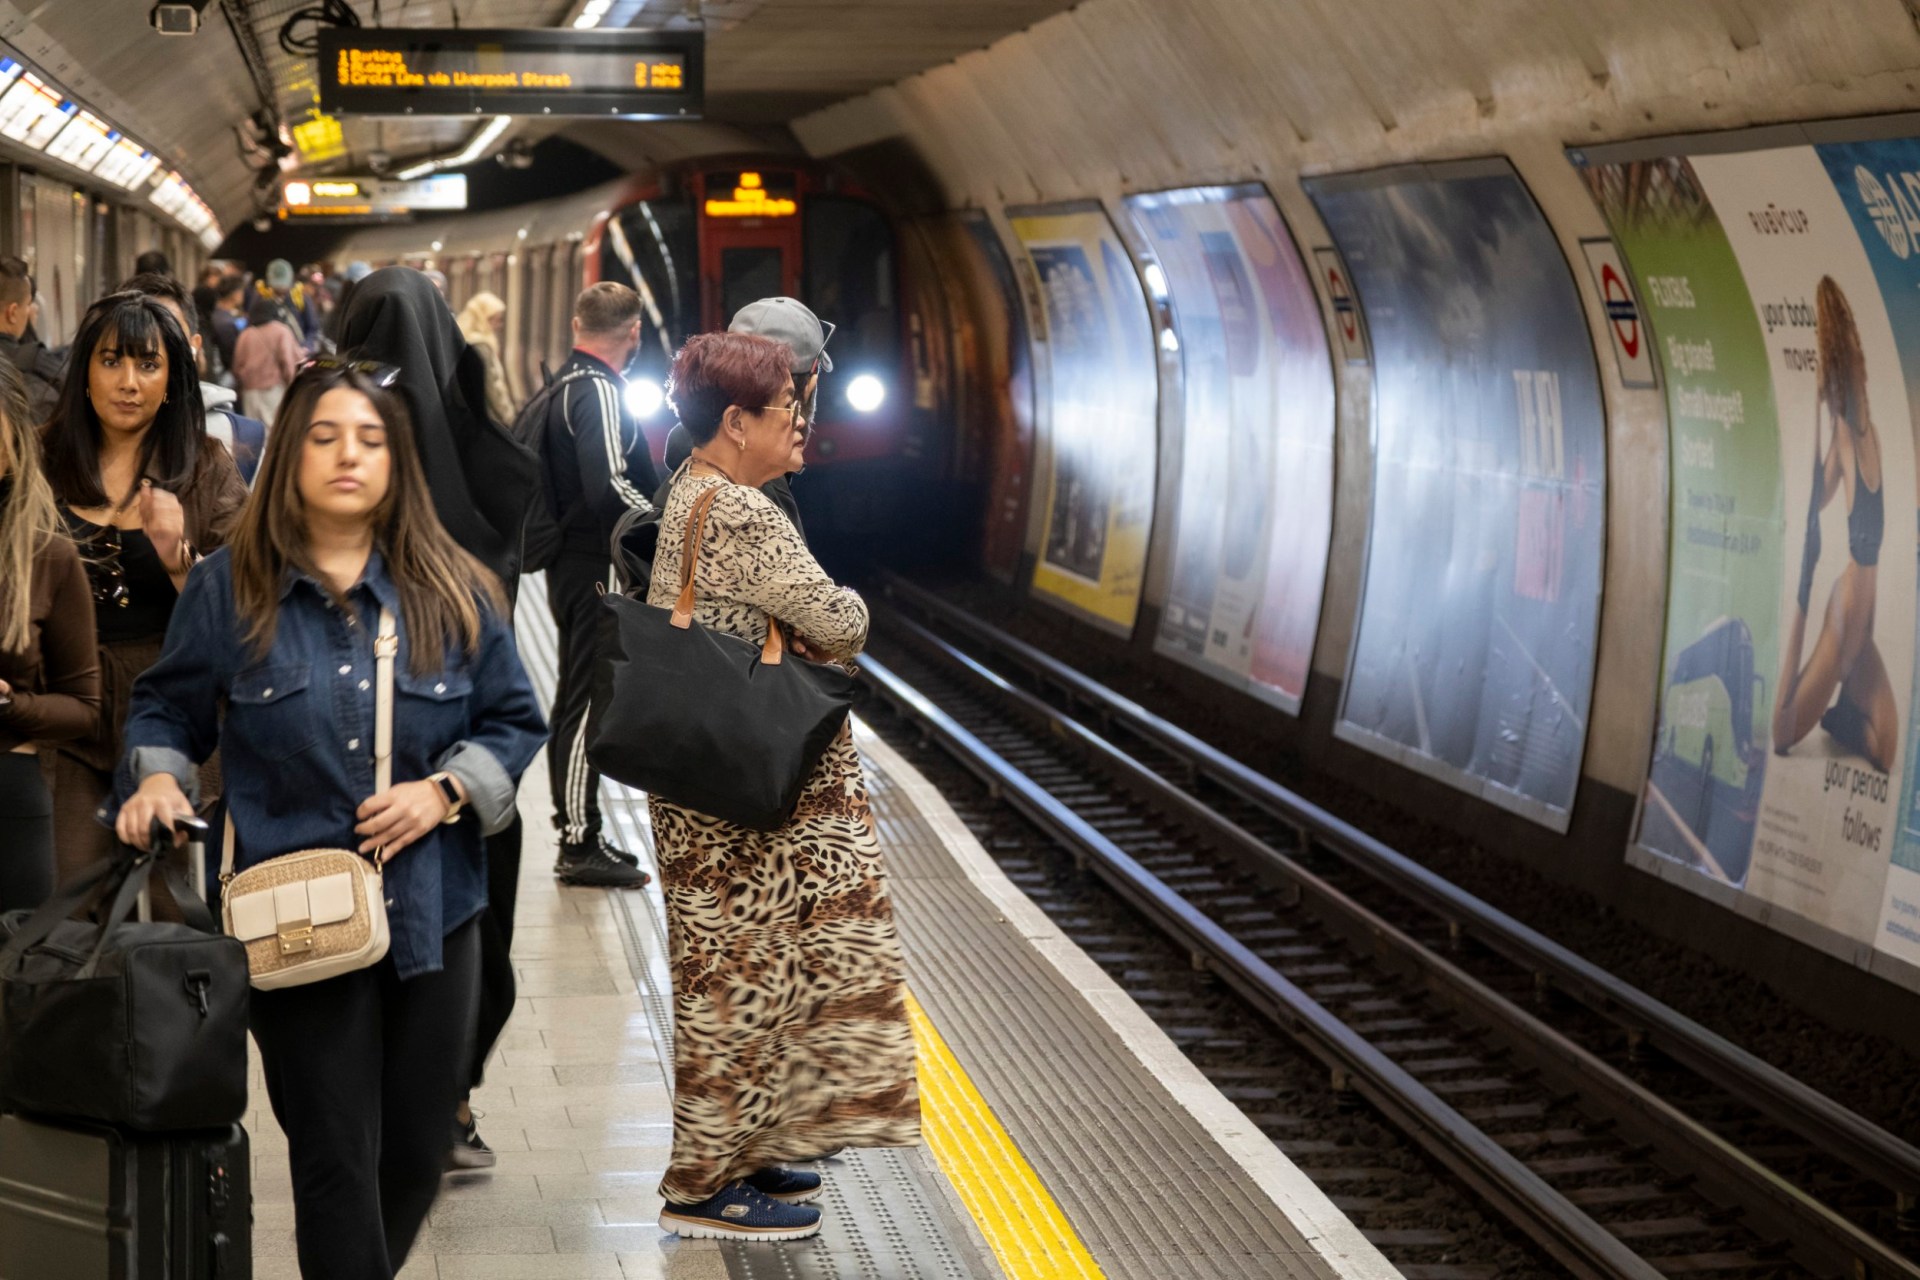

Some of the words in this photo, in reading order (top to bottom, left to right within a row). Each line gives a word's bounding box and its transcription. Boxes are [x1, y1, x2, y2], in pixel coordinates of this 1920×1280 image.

[427, 71, 451, 86] via
[453, 71, 518, 88] Liverpool
[521, 71, 572, 88] Street
[1760, 303, 1787, 334] your
[1783, 347, 1818, 372] moves
[1823, 759, 1851, 793] your
[1849, 765, 1889, 804] period
[1841, 807, 1882, 852] follows
